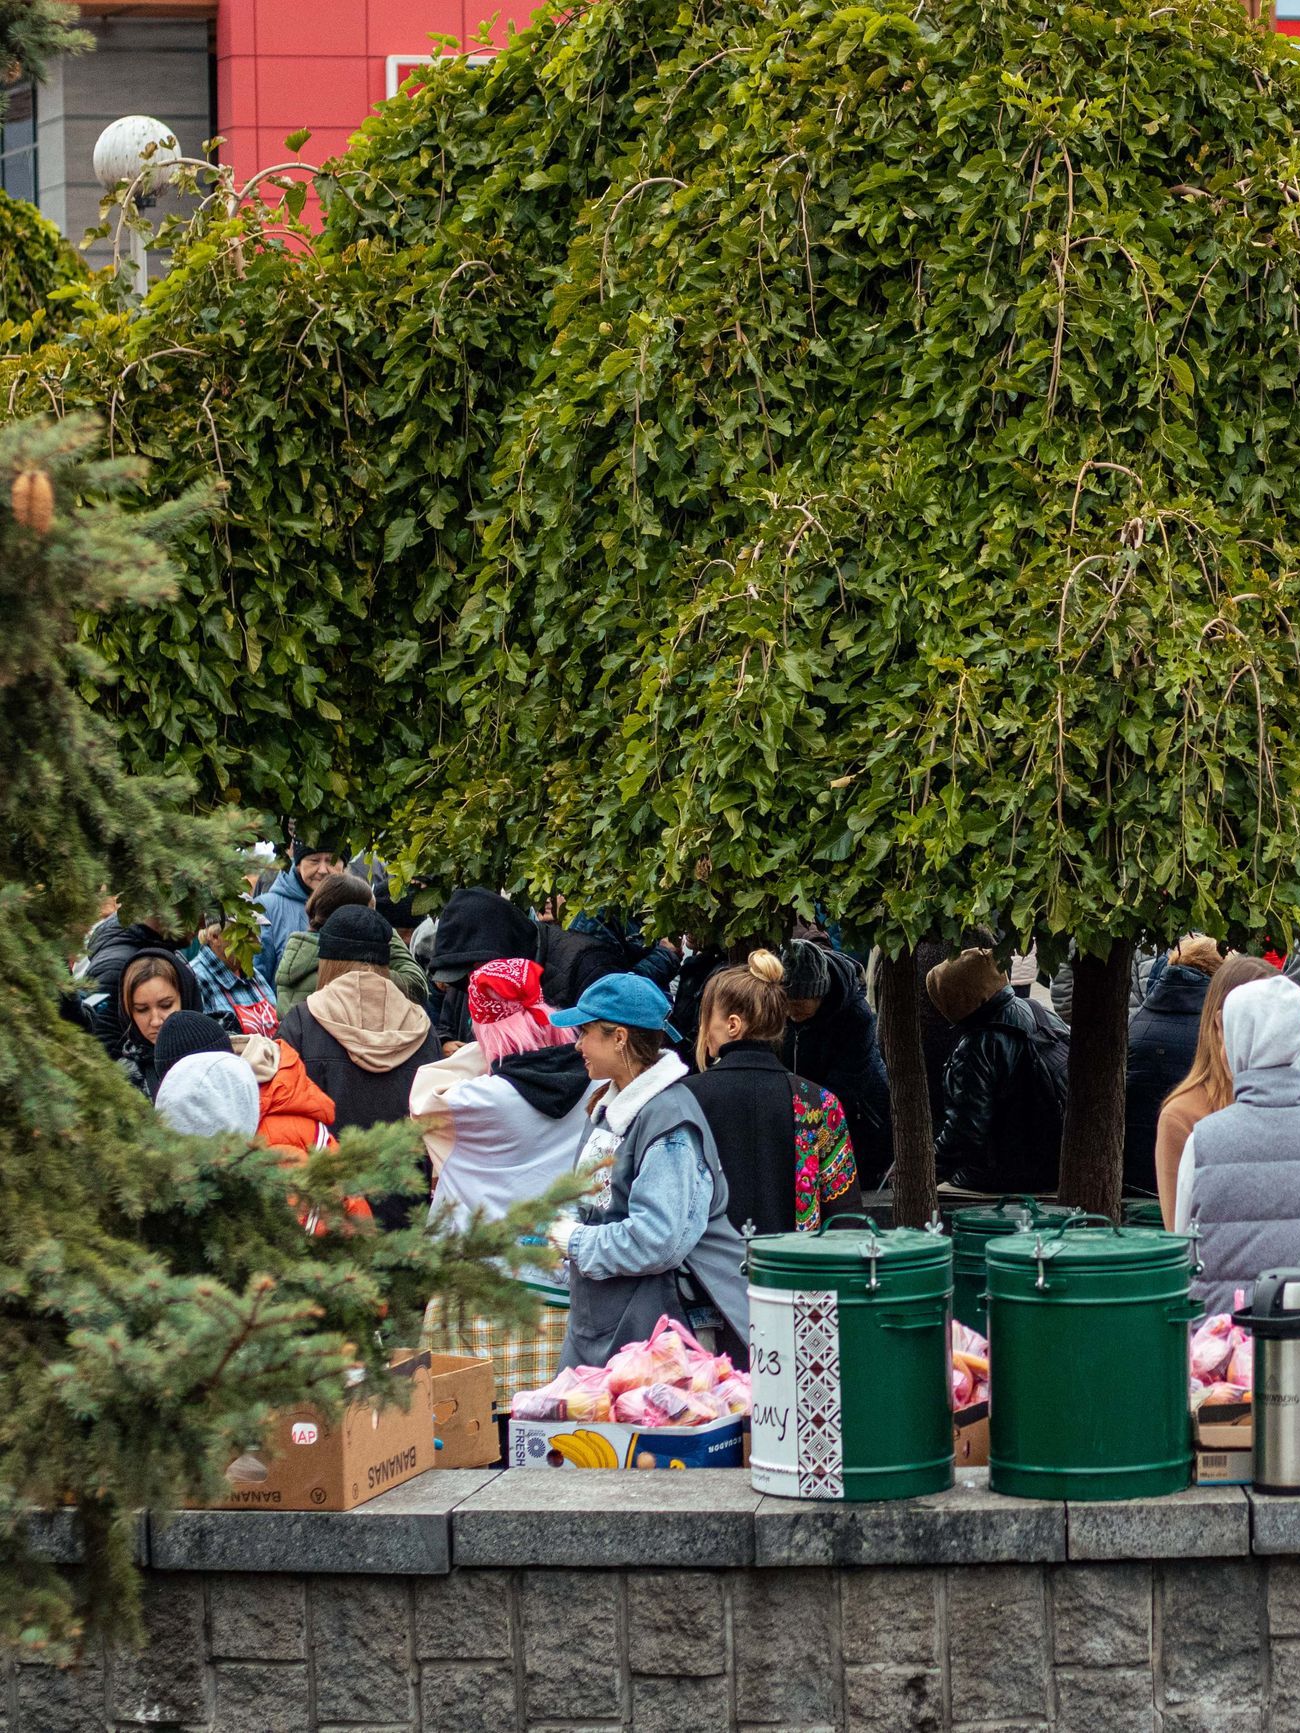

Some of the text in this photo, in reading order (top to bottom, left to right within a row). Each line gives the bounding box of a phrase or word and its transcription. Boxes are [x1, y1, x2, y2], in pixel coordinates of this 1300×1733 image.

[753, 1402, 790, 1442] ому
[516, 1428, 526, 1467] FRESH
[708, 1436, 742, 1454] ECUADOR
[368, 1446, 416, 1490] BANANAS
[230, 1490, 282, 1503] BANAN
